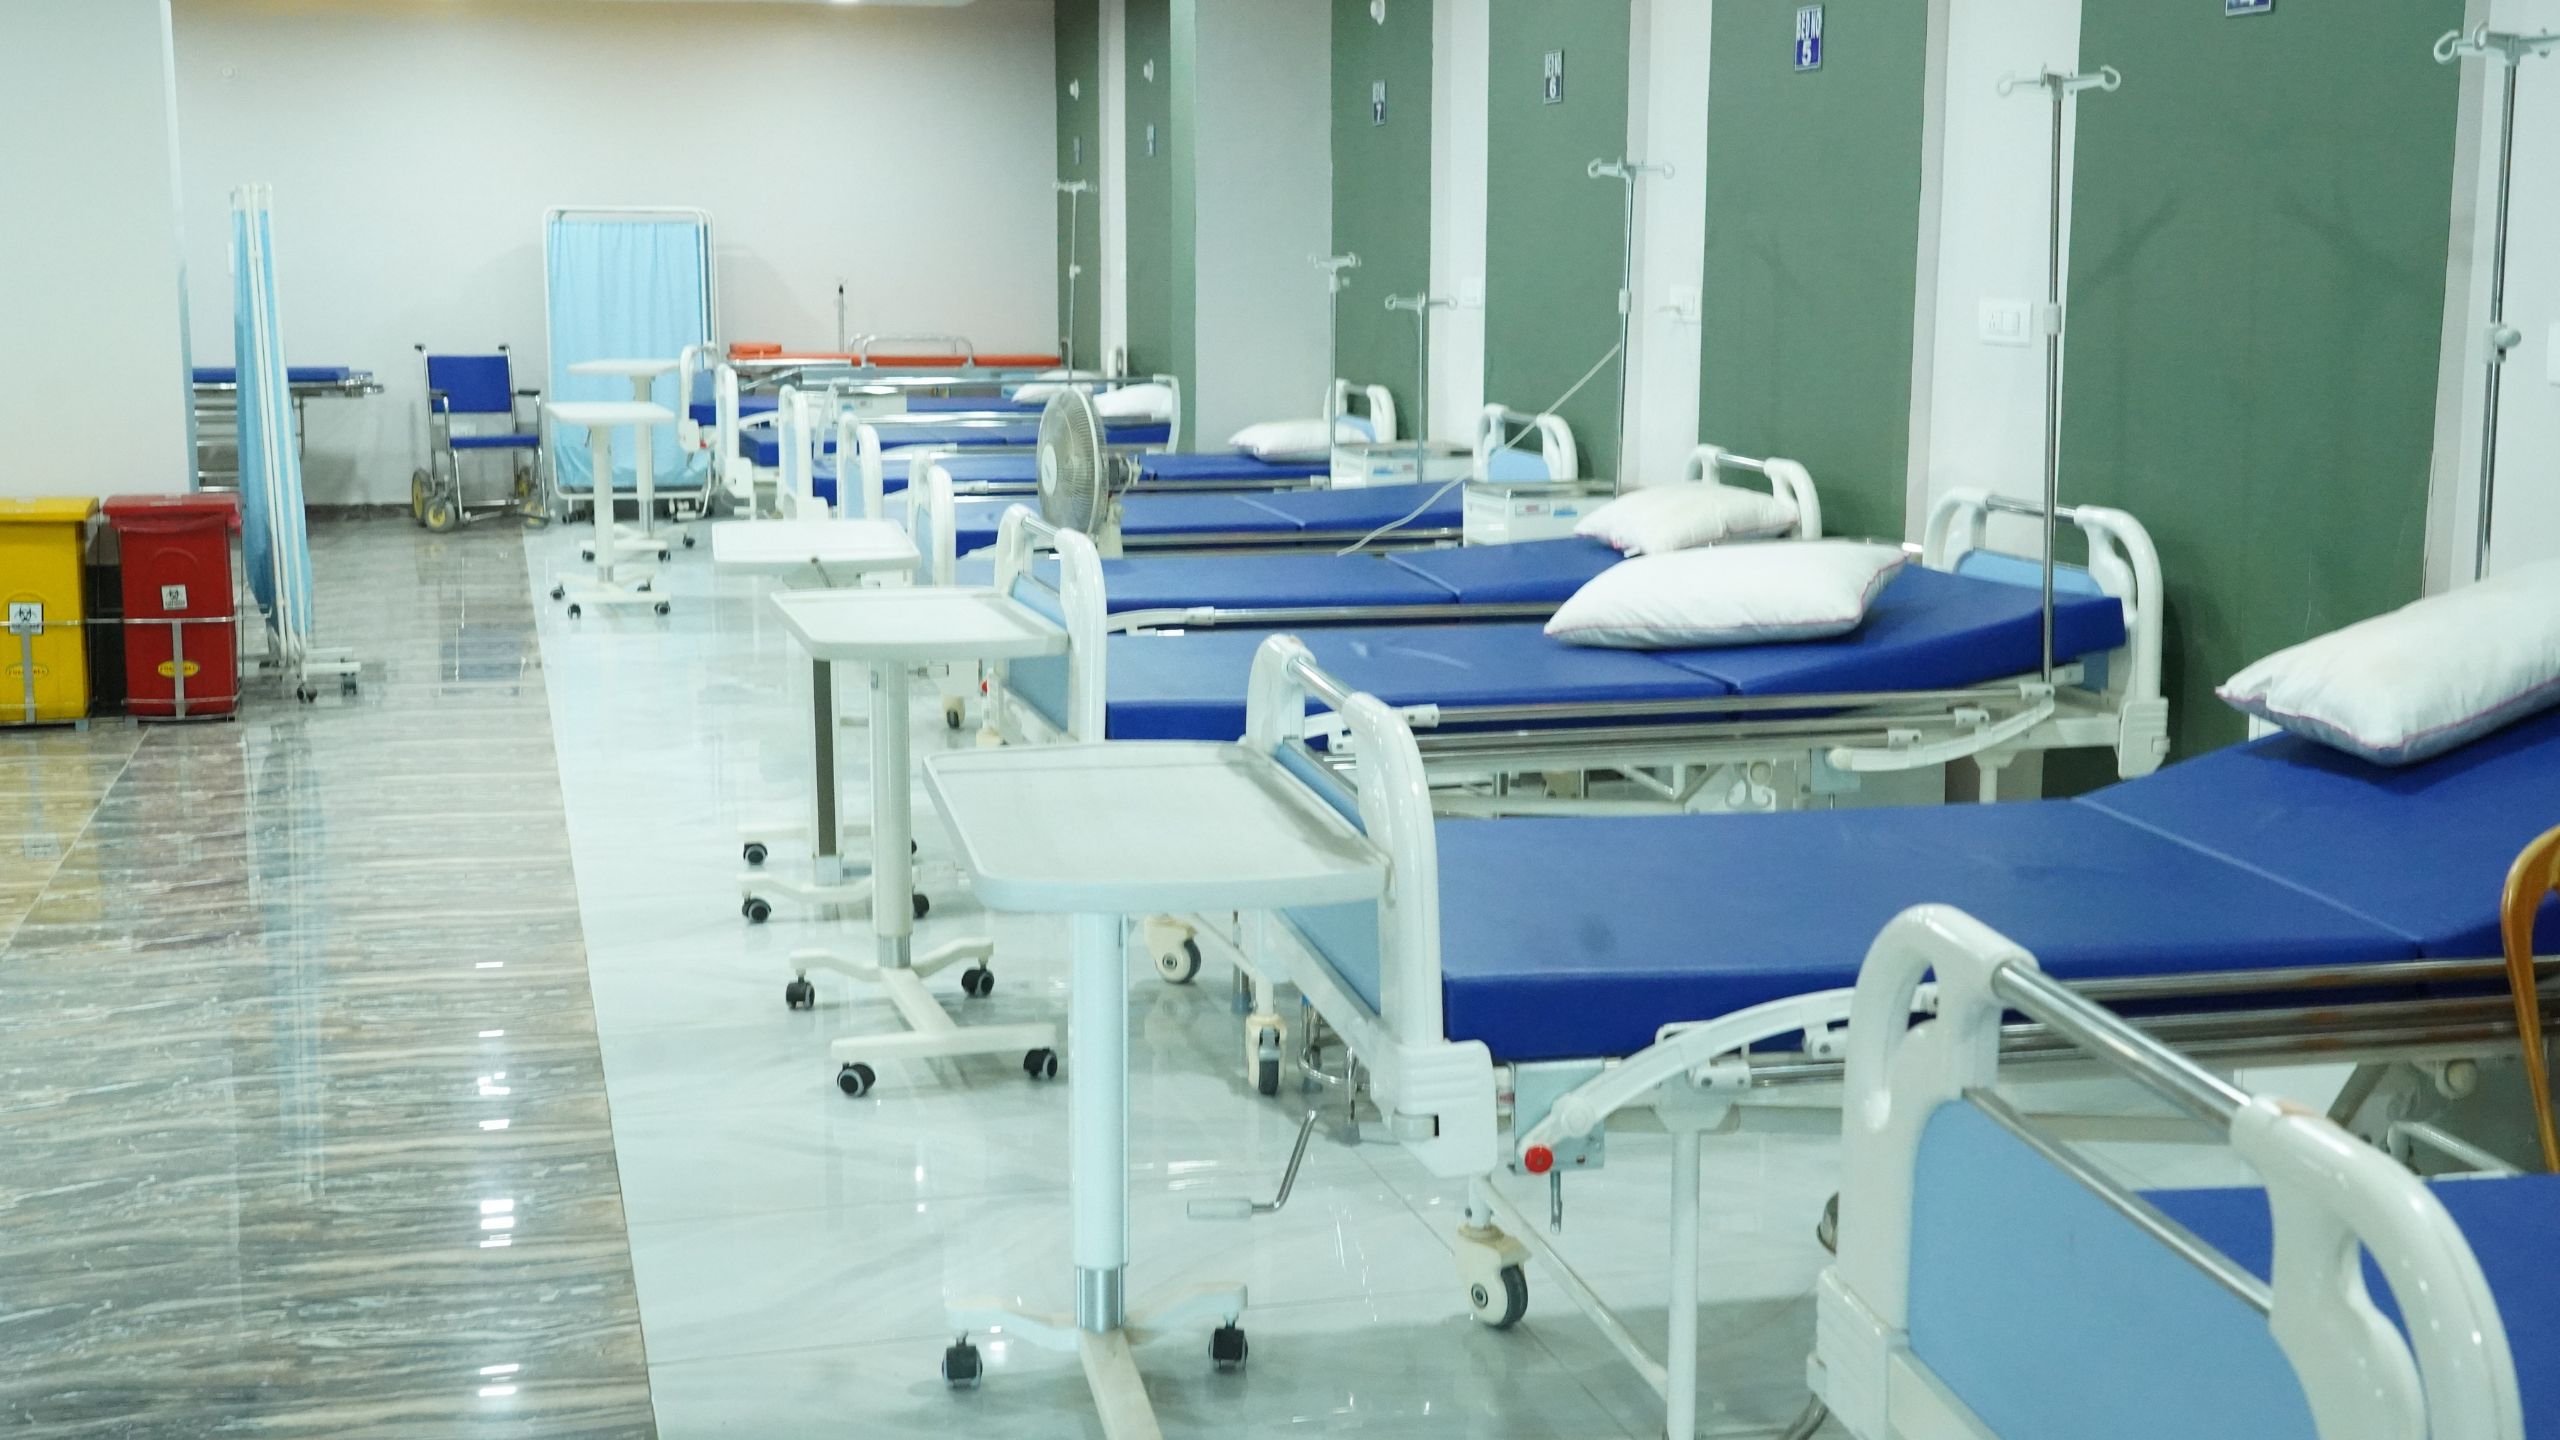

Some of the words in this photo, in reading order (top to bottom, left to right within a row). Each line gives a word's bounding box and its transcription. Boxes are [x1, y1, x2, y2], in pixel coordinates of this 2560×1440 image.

[1797, 9, 1810, 40] BED
[1811, 8, 1821, 39] NO
[1802, 40, 1811, 65] 5
[1550, 77, 1556, 99] 6
[1376, 103, 1381, 123] 7
